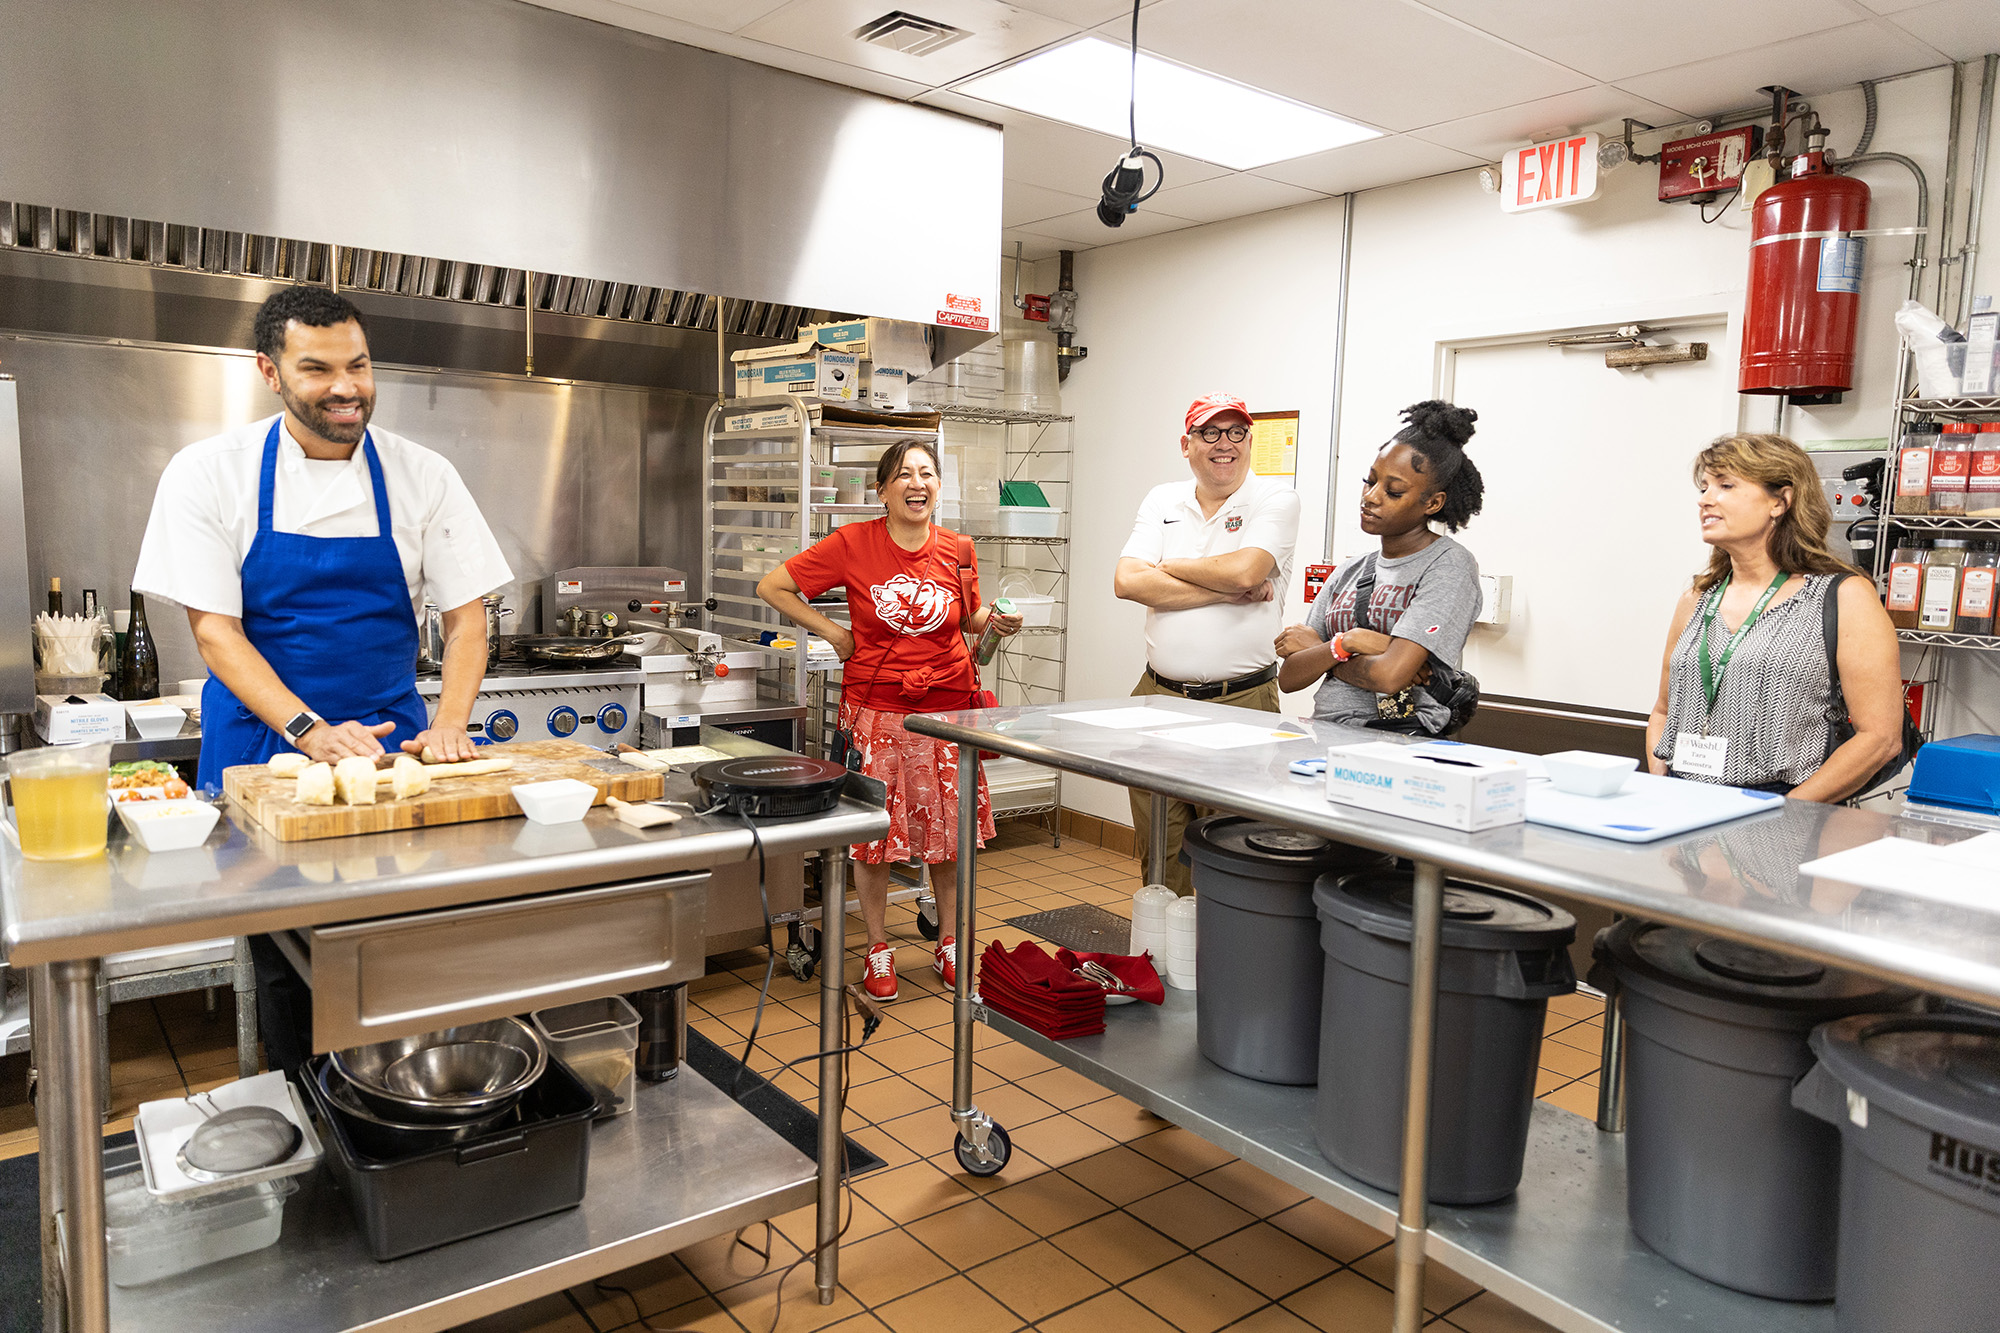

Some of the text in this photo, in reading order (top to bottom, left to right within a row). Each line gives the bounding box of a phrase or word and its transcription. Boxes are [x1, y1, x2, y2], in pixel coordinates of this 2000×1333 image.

[1666, 145, 1685, 153] MODEL
[1517, 137, 1587, 206] EXIT
[938, 311, 988, 327] CAPTIVEAIRE
[824, 354, 855, 364] MONOGRAM
[737, 367, 764, 379] MONOGRAM
[1690, 739, 1723, 751] WashU
[1334, 767, 1393, 789] MONOGRAM
